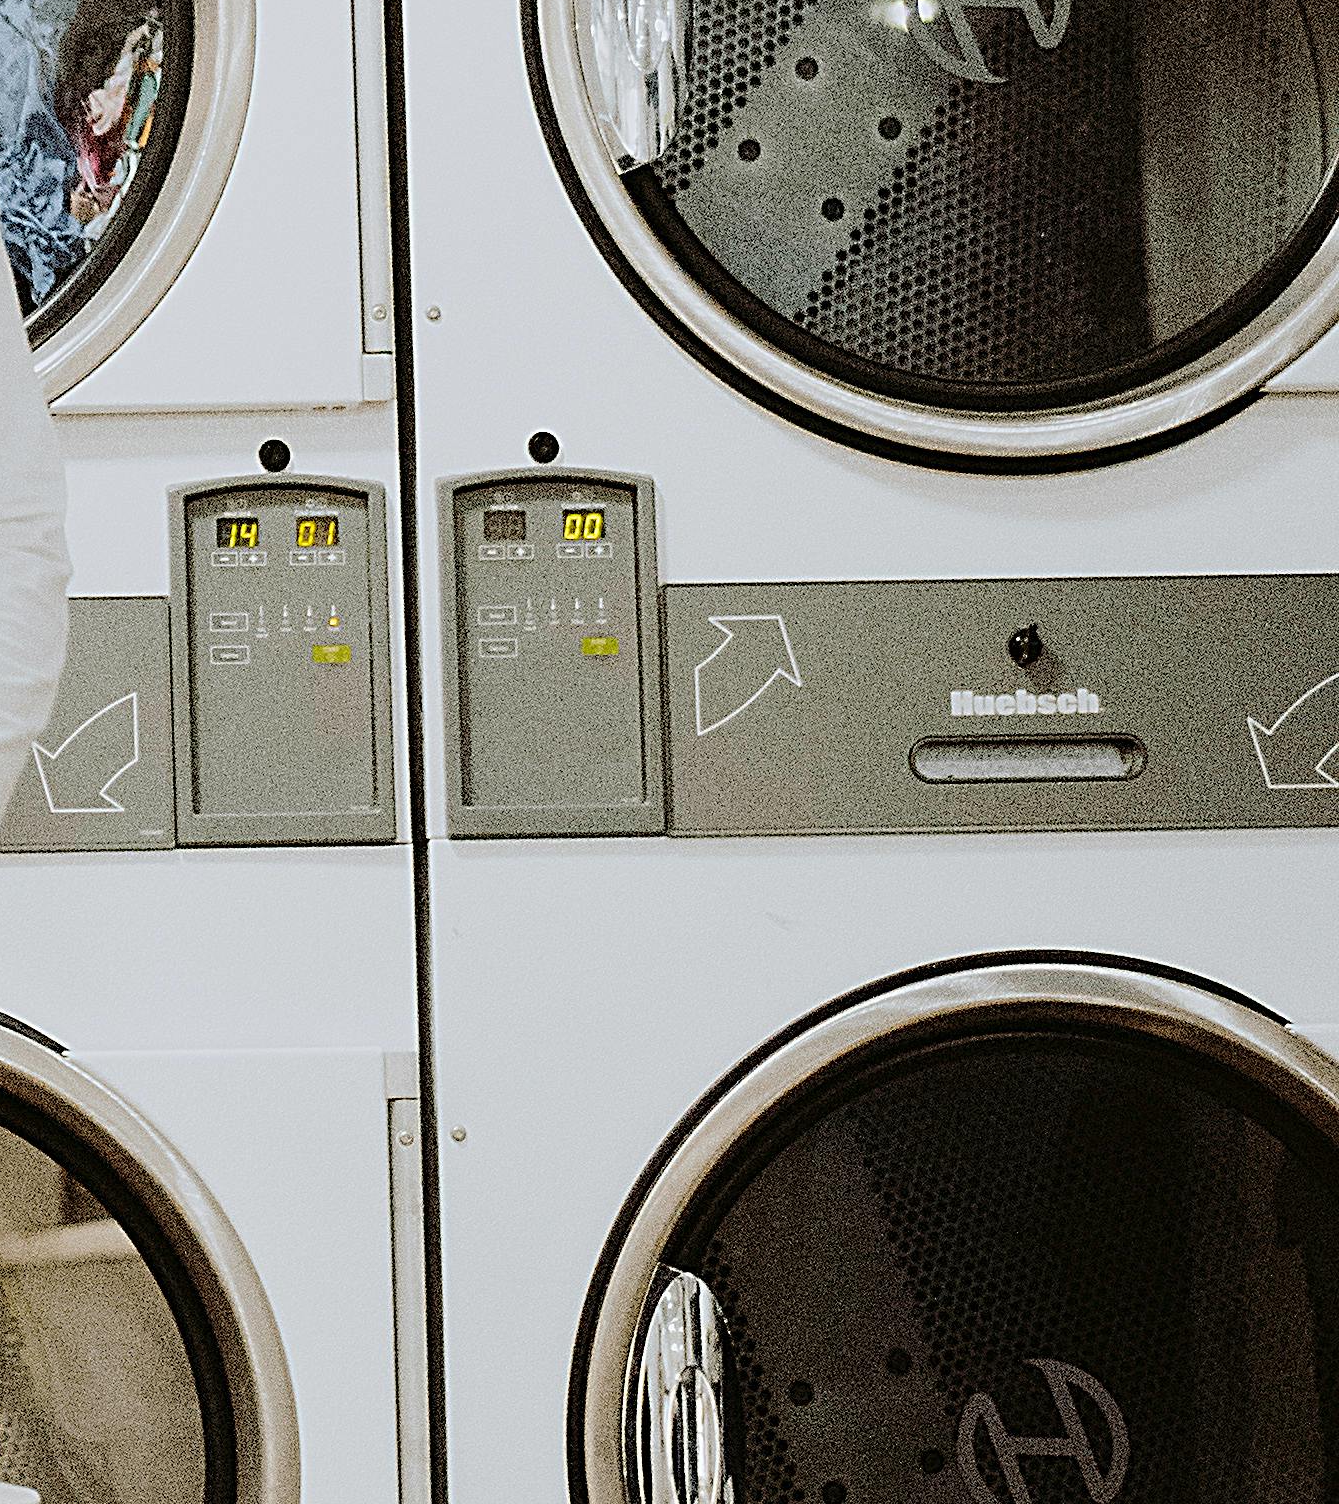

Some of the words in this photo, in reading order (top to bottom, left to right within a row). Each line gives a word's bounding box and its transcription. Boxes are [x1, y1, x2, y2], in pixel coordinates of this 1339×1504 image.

[228, 522, 258, 548] 14
[297, 520, 336, 547] 01
[562, 512, 603, 541] 00
[950, 688, 1100, 717] Huebsch
